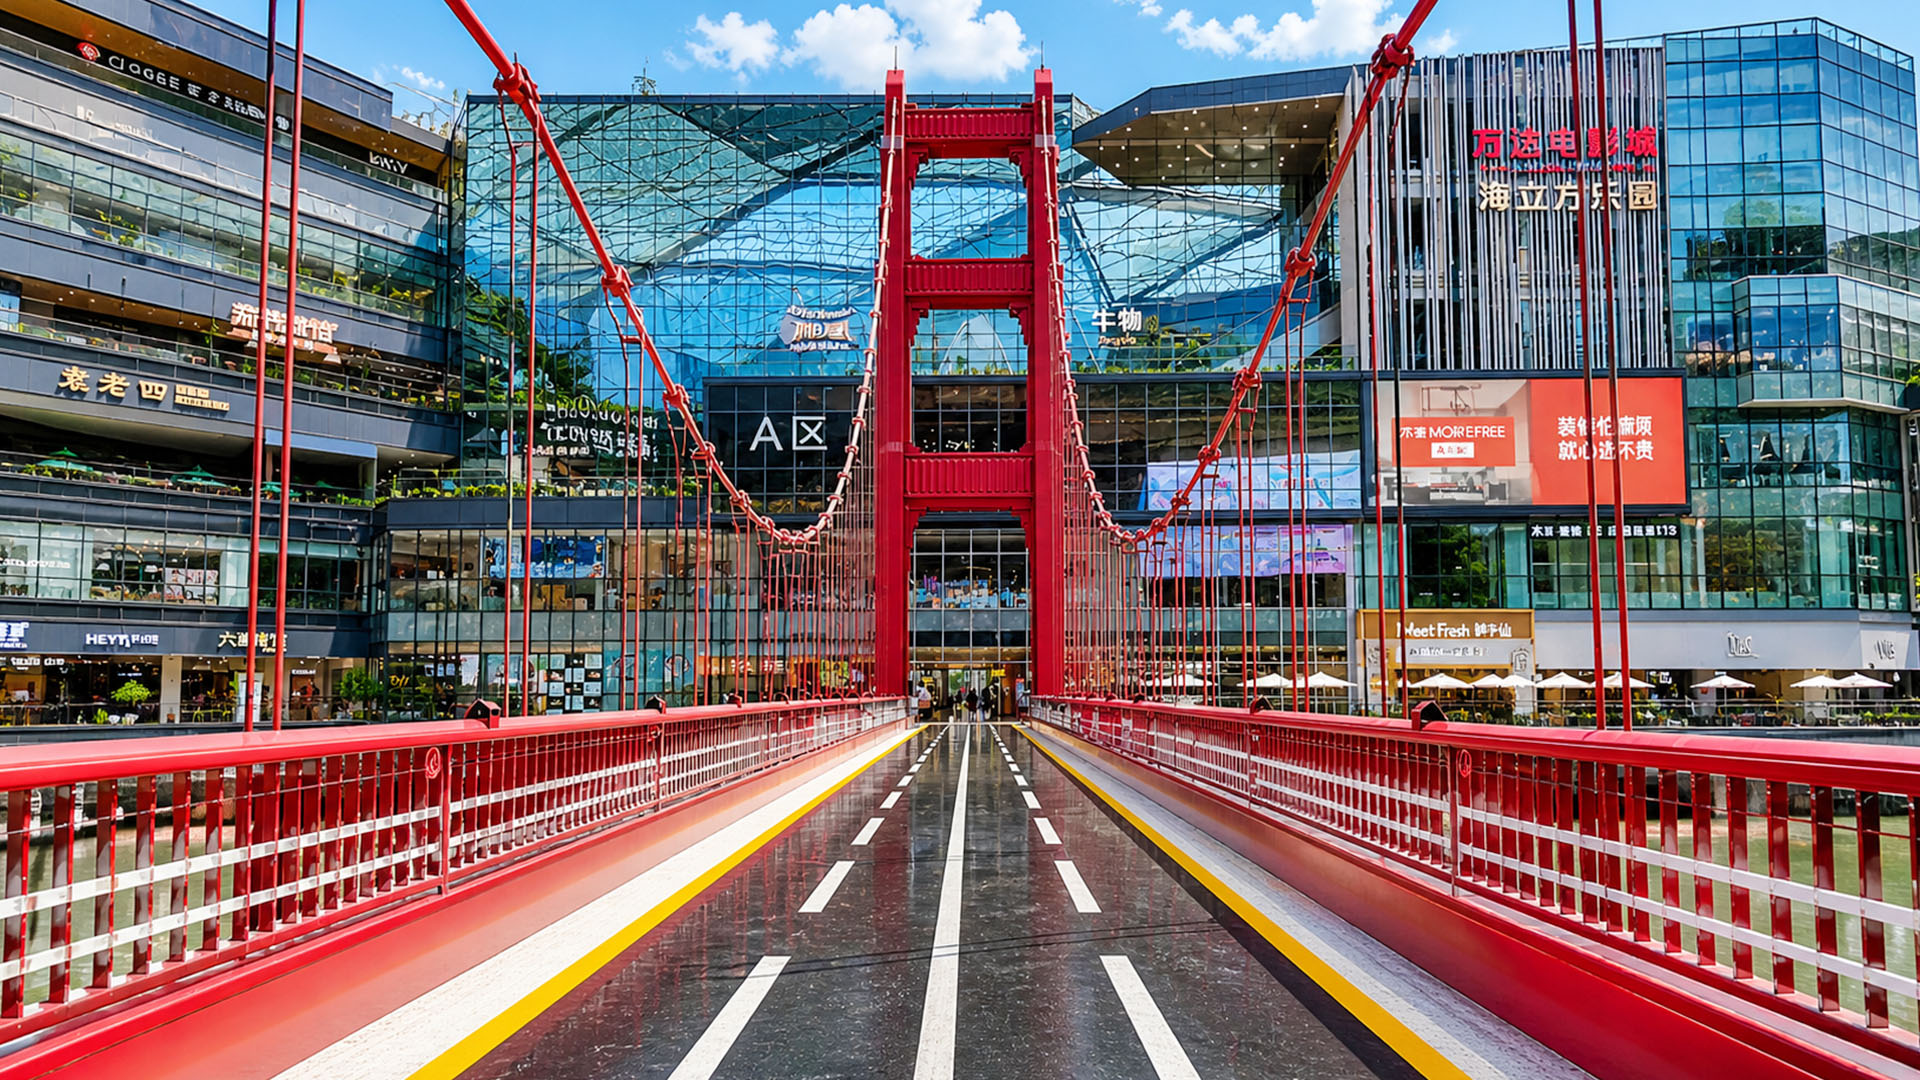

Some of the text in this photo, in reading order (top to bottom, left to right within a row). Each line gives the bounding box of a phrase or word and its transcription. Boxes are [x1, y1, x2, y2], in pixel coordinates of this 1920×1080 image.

[1479, 180, 1658, 212] 海立方乐园
[1437, 622, 1471, 637] Fresh
